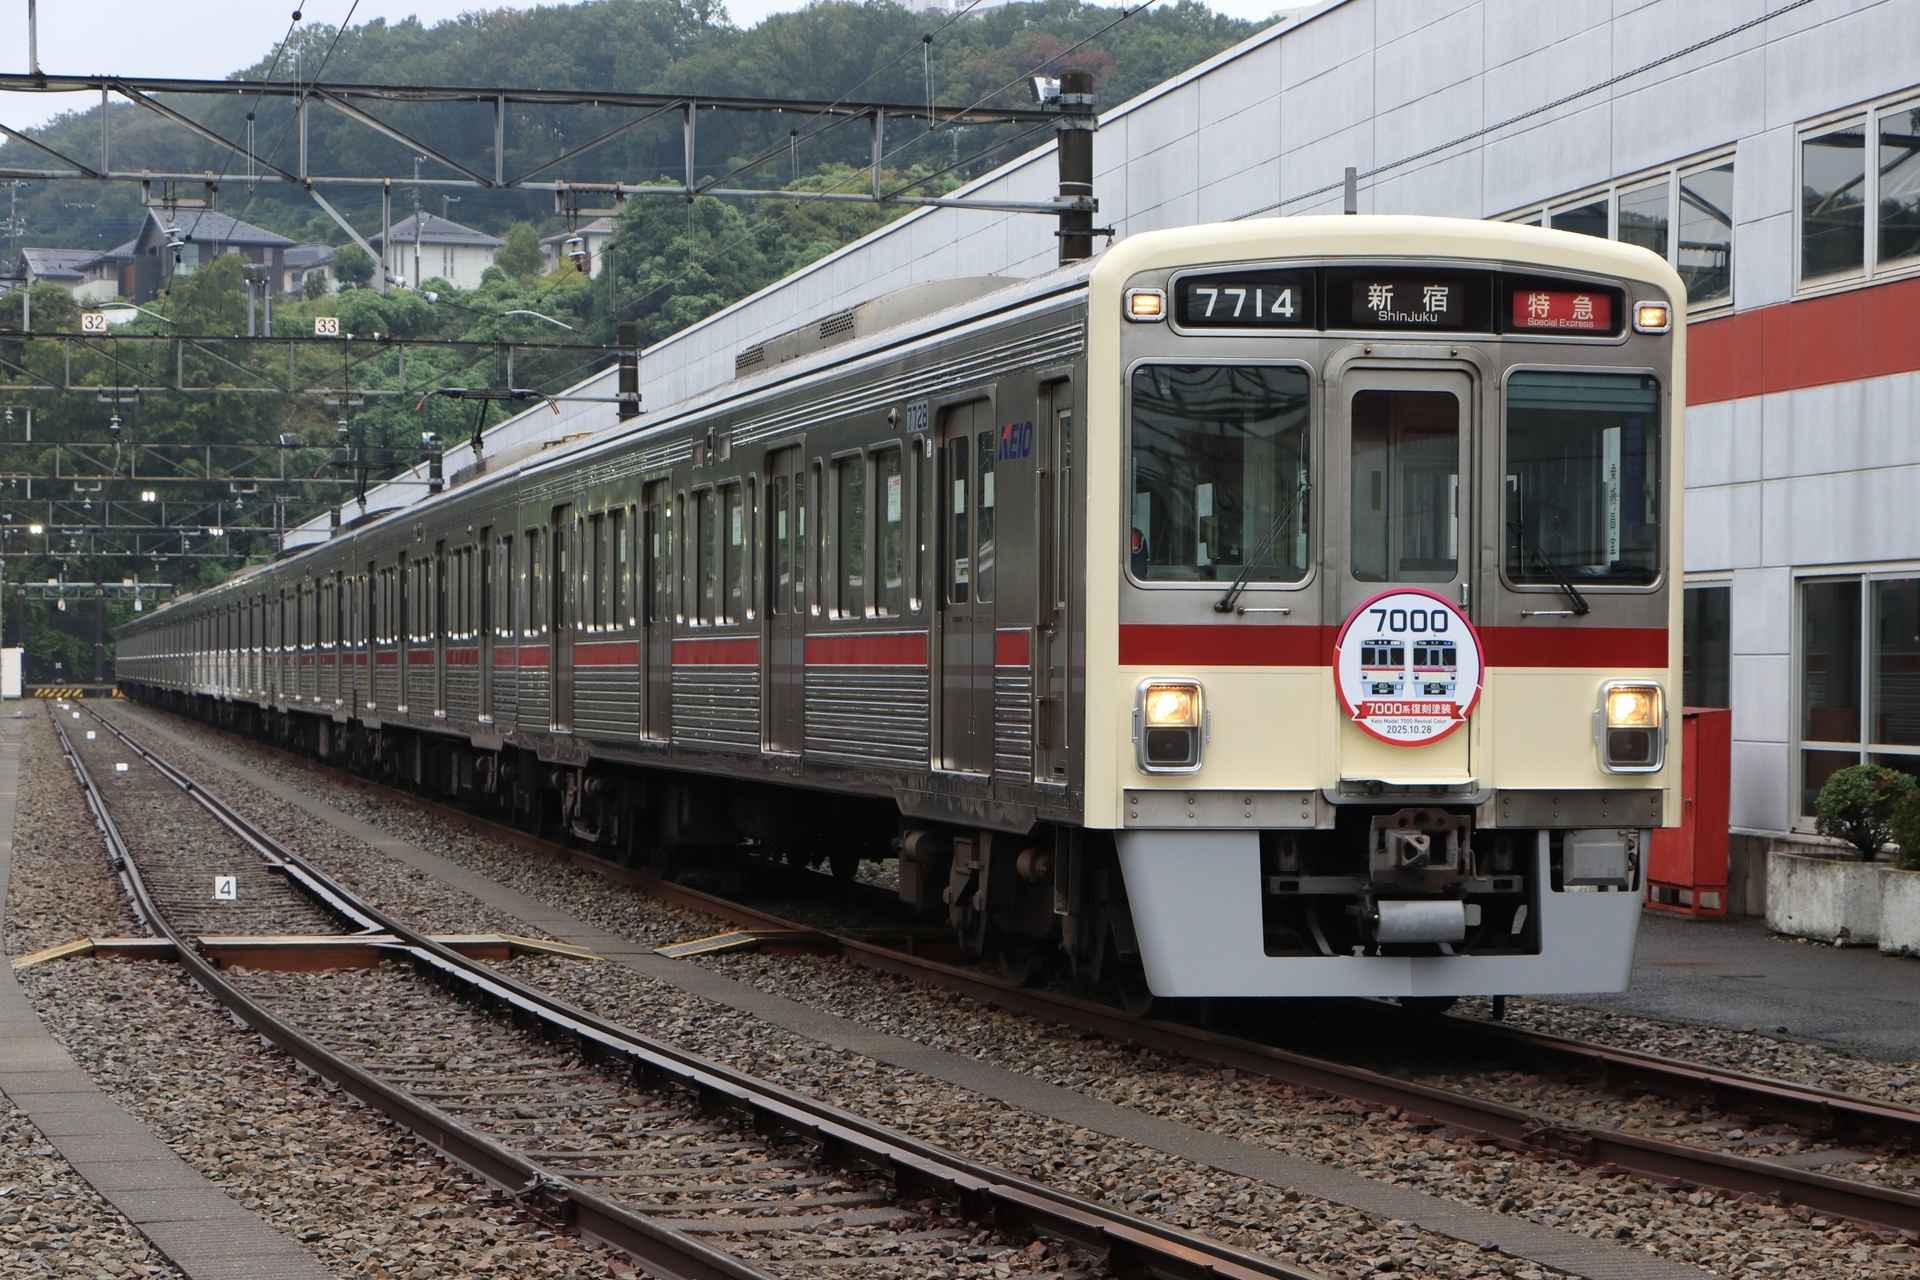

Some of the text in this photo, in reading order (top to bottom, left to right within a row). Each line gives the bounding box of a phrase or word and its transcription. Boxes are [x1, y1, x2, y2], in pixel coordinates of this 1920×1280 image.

[1196, 288, 1294, 317] 7714
[1367, 283, 1449, 312] 新宿
[1528, 292, 1594, 320] 特急
[85, 315, 104, 330] 32
[1378, 310, 1438, 322] Shinjuku
[1527, 317, 1594, 329] Special Express
[317, 318, 336, 334] 33
[907, 403, 928, 432] 7728
[999, 421, 1033, 460] KEIO
[1370, 609, 1448, 632] 7000
[1366, 702, 1452, 715] 7000系復刻塗装
[1386, 725, 1432, 734] 2025.10.28
[220, 880, 231, 896] 4
